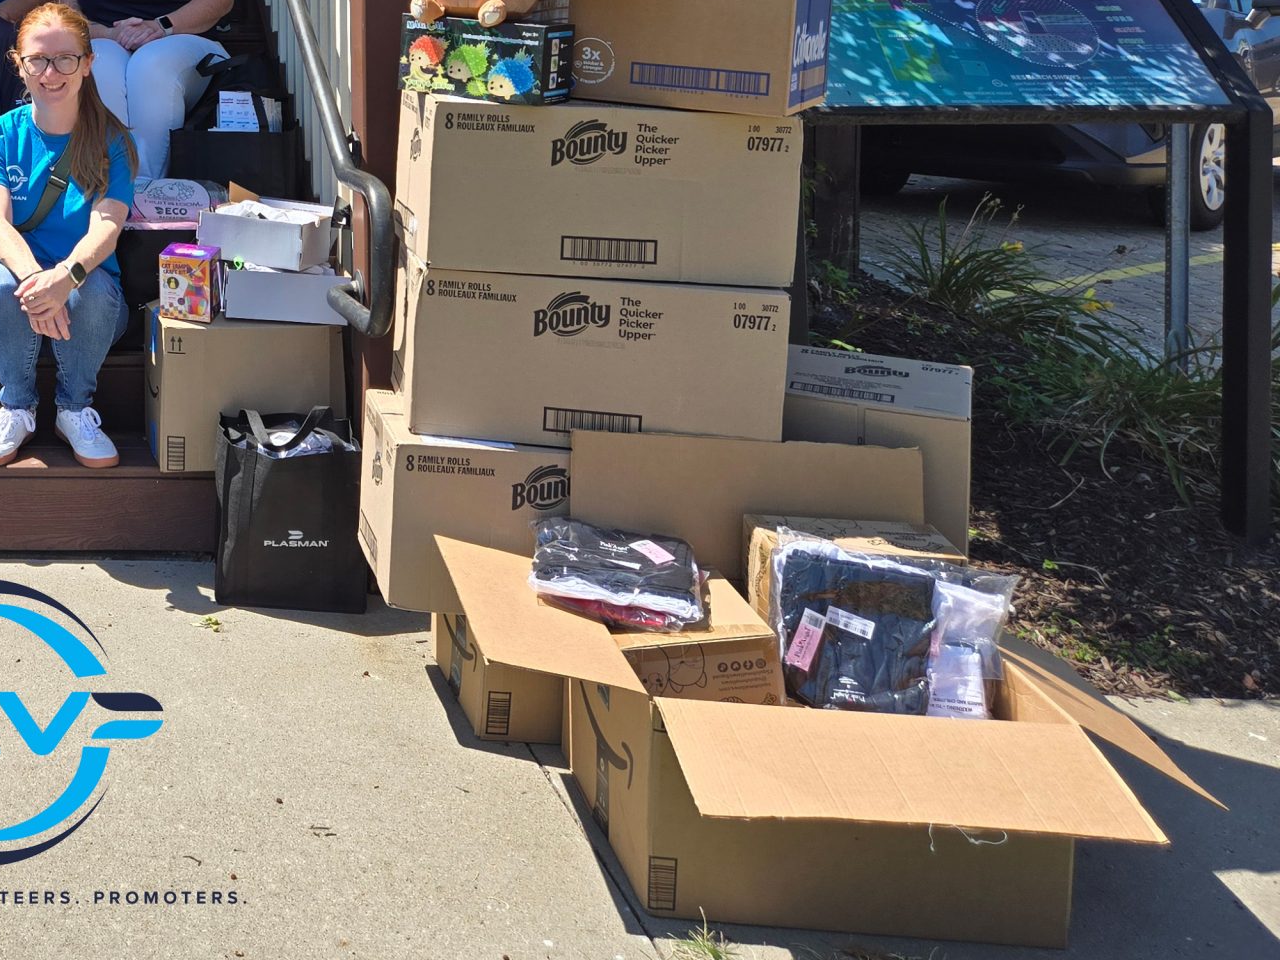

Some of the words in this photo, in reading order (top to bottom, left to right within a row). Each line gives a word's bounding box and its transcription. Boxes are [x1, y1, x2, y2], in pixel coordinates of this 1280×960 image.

[582, 46, 601, 60] 3x
[445, 112, 454, 130] 8
[457, 113, 484, 123] FAMILY
[487, 114, 510, 123] ROLLS
[456, 121, 495, 132] ROULEAUX
[497, 123, 535, 133] FAMILIAUX
[637, 123, 658, 133] The
[636, 134, 679, 146] Quicker
[747, 137, 784, 152] 07977
[551, 128, 628, 167] Bounty
[635, 145, 670, 155] Picker
[634, 155, 667, 167] Upper
[165, 207, 188, 216] ECO
[426, 279, 435, 296] 8
[438, 280, 466, 290] FAMILY
[468, 282, 492, 291] ROLLS
[438, 289, 477, 299] ROULEAUX
[478, 291, 517, 302] FAMILIAUX
[620, 297, 642, 307] The
[619, 308, 664, 320] Quicker
[761, 304, 779, 313] 30772
[533, 300, 611, 337] Bounty
[619, 319, 654, 329] Picker
[733, 313, 771, 331] 07977
[771, 323, 776, 332] 2
[618, 329, 652, 341] Upper
[844, 365, 910, 378] Bounty
[406, 454, 415, 472] 8
[418, 455, 445, 464] FAMILY
[447, 456, 470, 466] ROLLS
[417, 464, 455, 474] ROULEAUX
[457, 466, 495, 477] FAMILIAUX
[511, 476, 570, 511] Boun
[263, 540, 328, 548] PLASMAN
